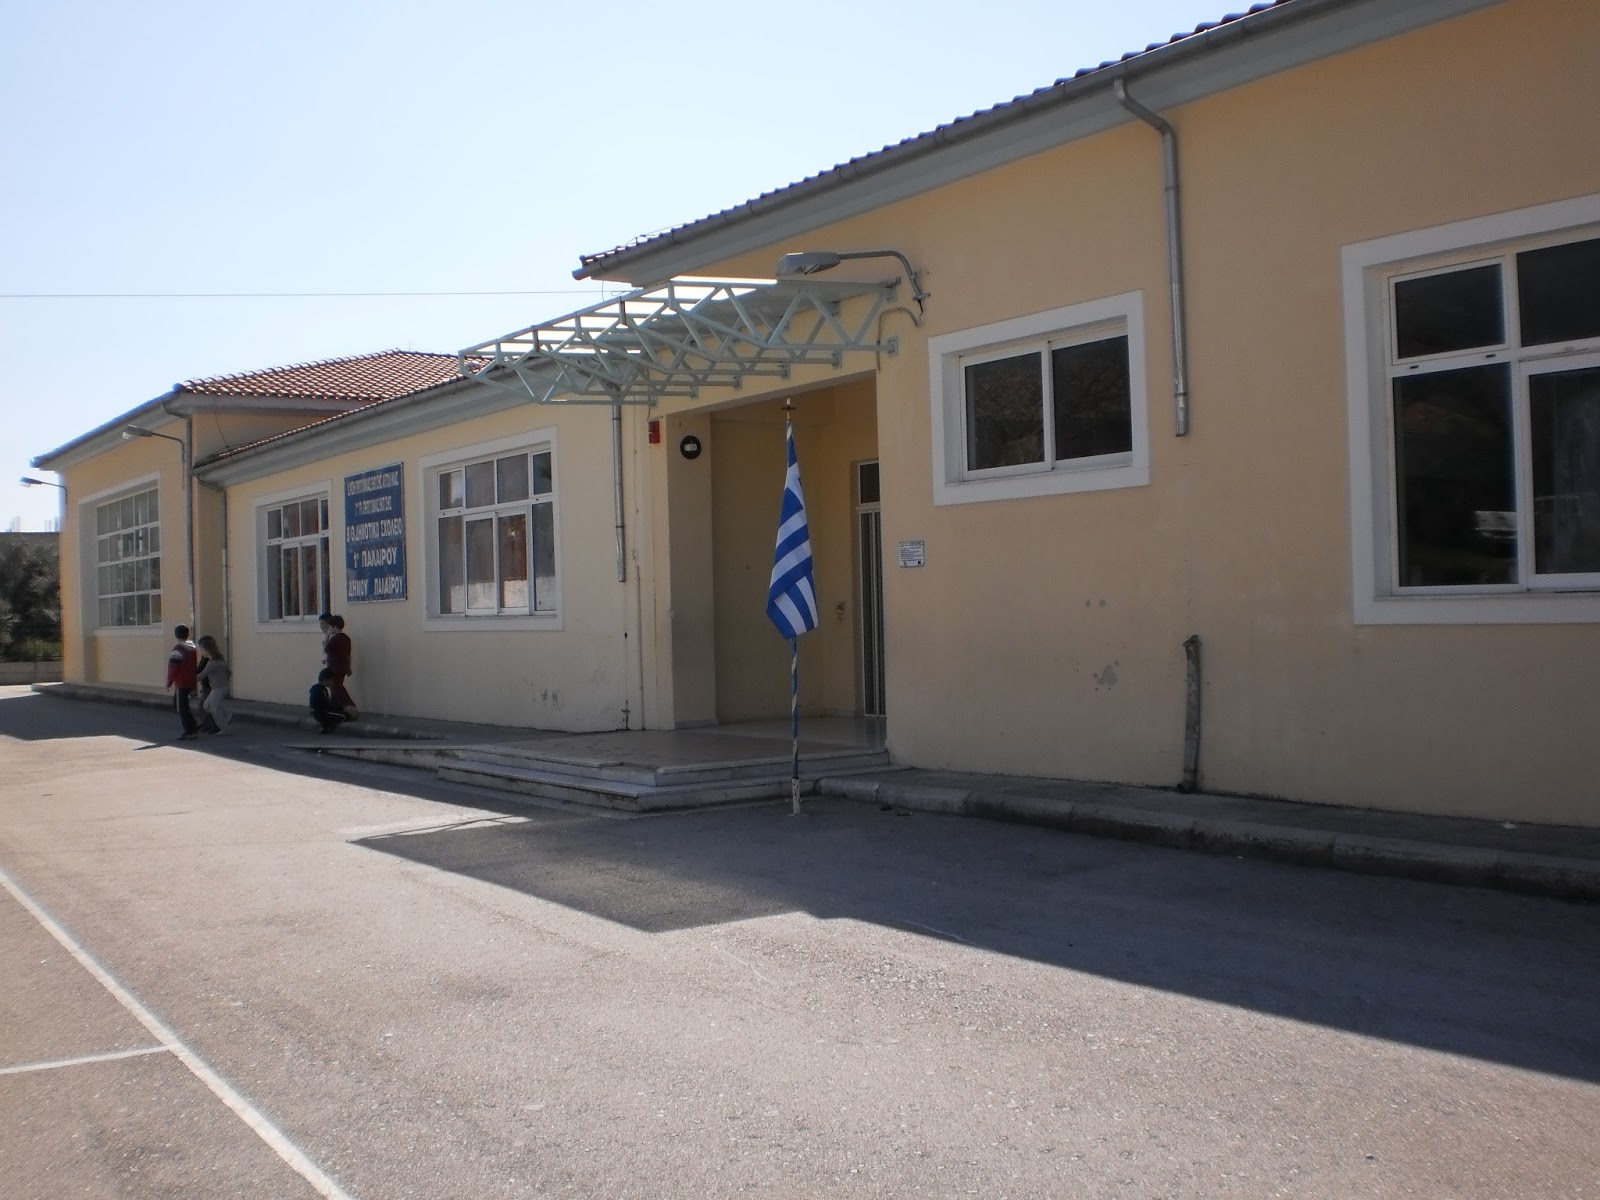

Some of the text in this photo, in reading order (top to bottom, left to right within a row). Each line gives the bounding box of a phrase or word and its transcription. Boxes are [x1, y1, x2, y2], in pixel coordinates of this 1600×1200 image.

[381, 517, 402, 537] ΣΧΟΛΕΙΟ
[361, 547, 398, 568] ΠΑΛΑΙΡΟΥ
[348, 575, 403, 597] ΔΗΜΟΥ ΠΑΛΑΙΡΟΥ
